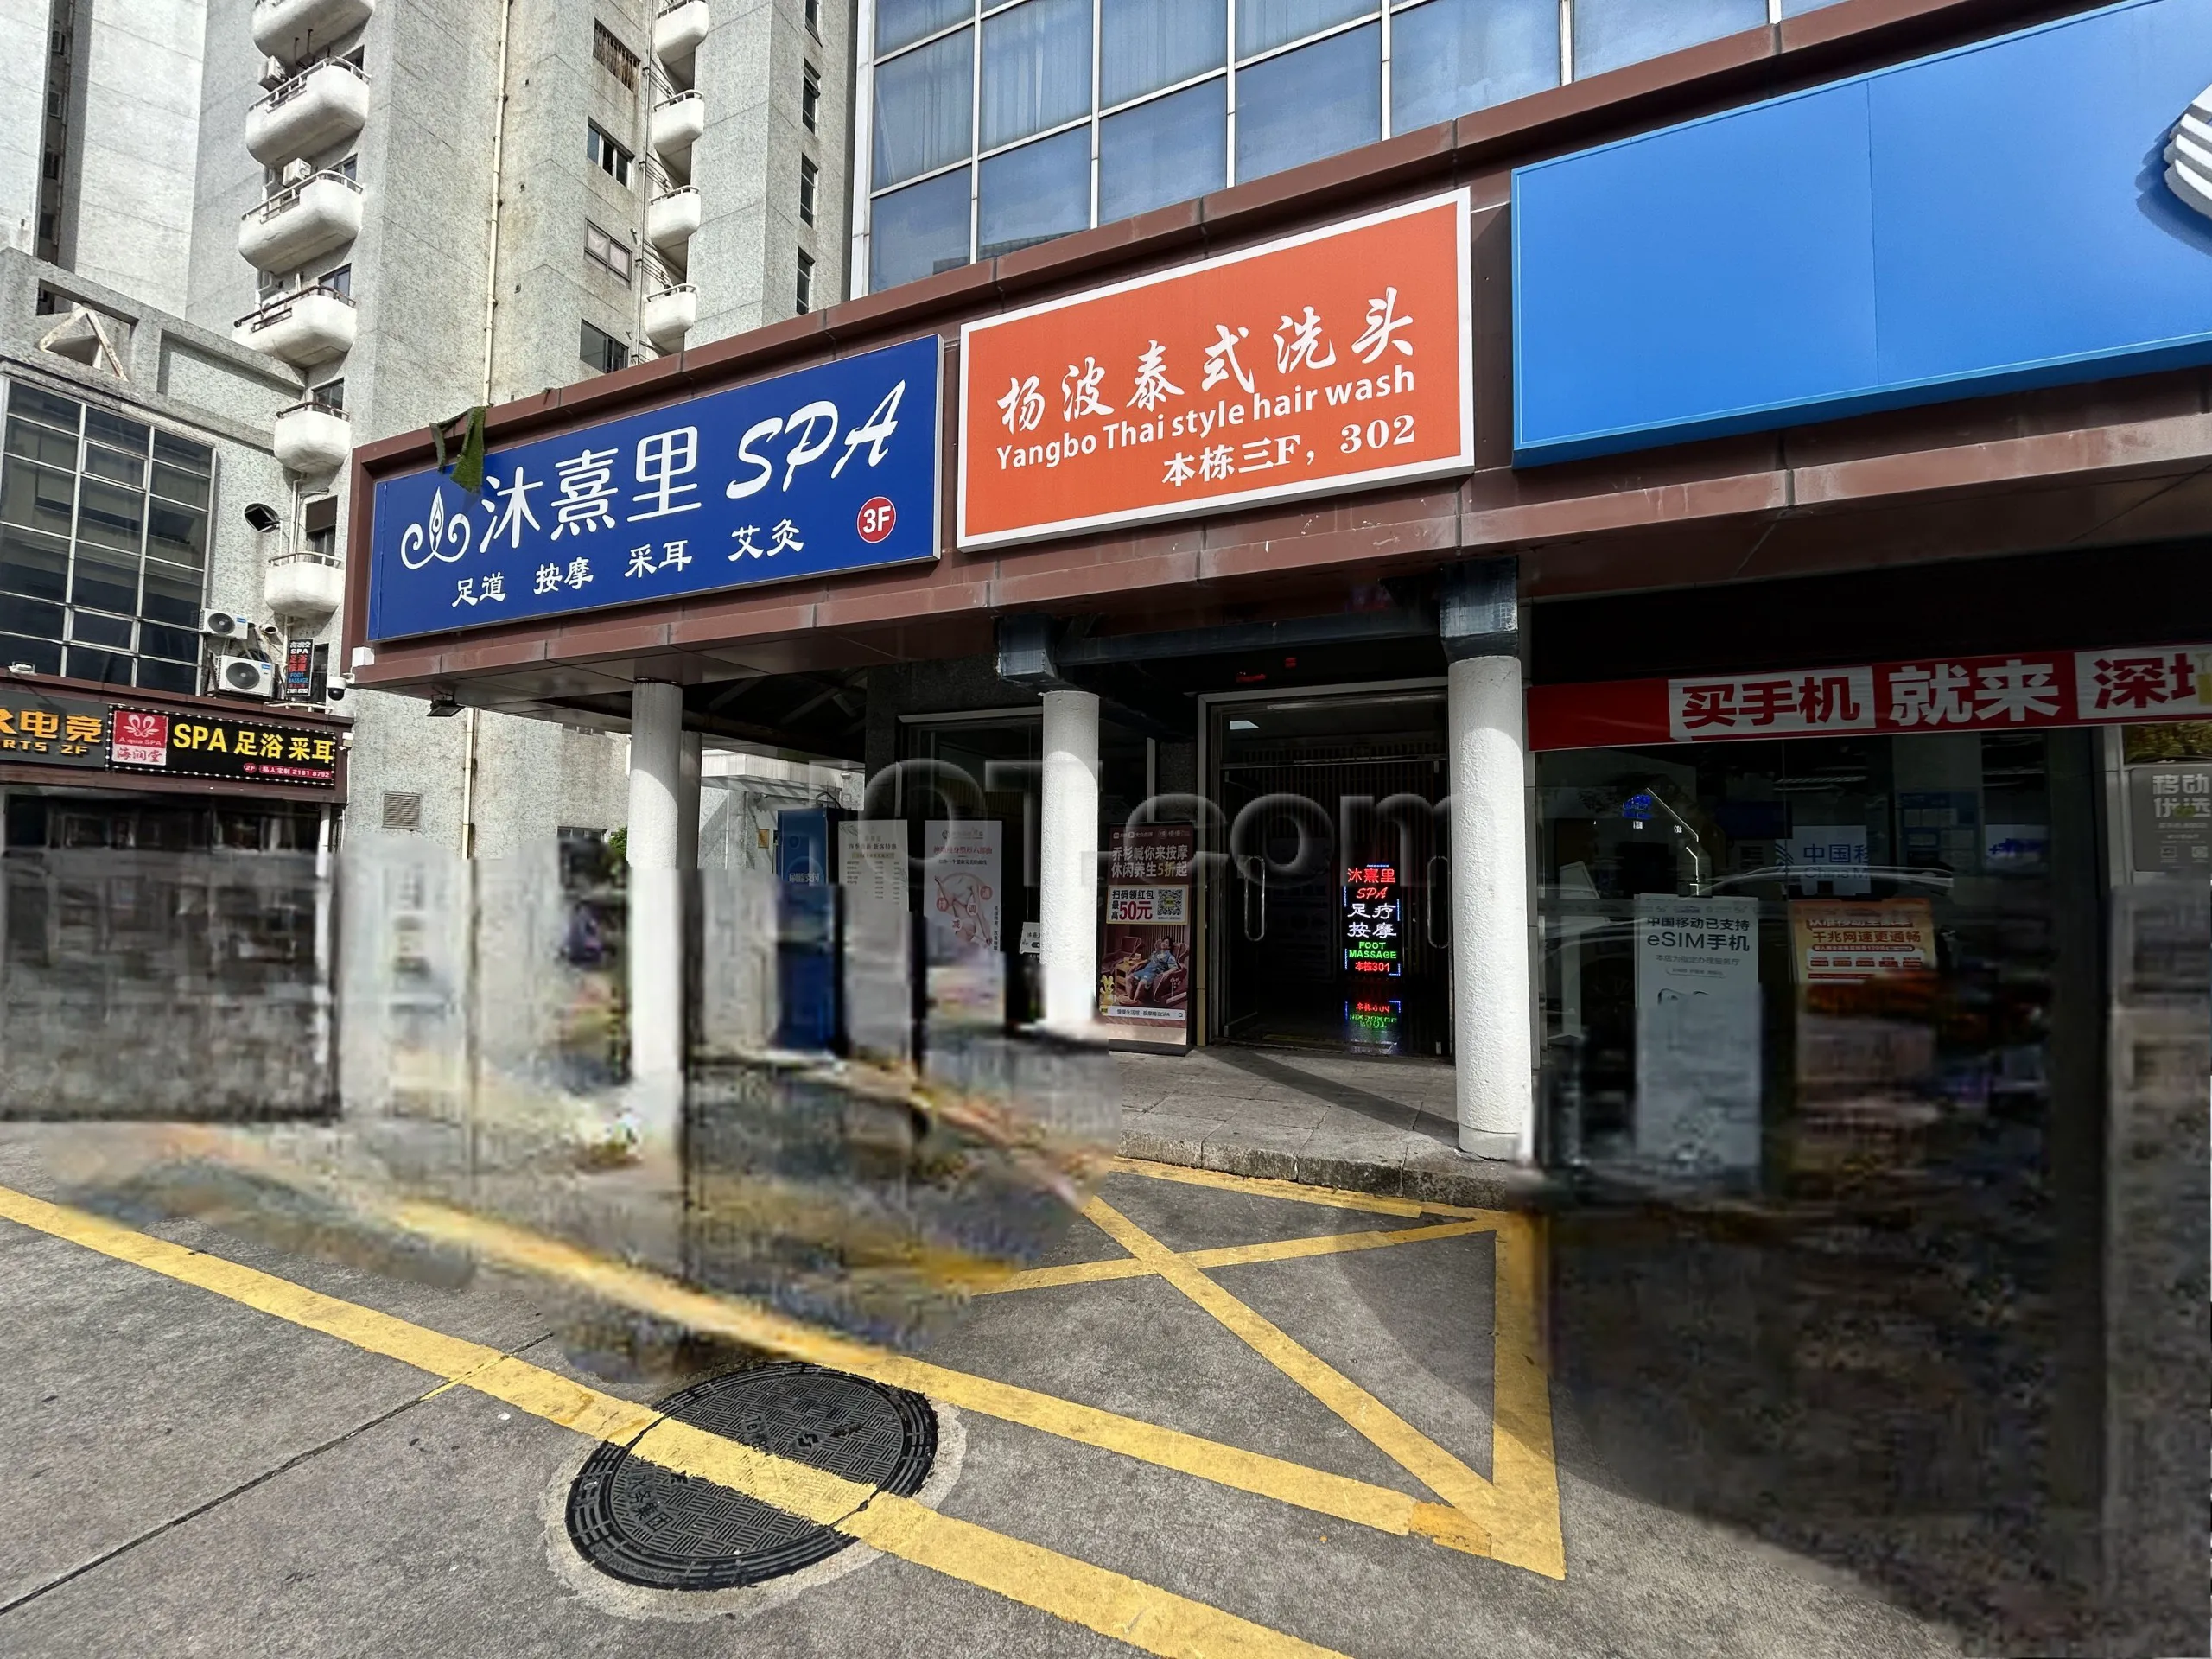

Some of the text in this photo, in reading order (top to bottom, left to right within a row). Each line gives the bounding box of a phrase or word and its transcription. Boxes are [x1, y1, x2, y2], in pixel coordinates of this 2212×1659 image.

[996, 286, 1414, 435] 杨波泰式洗头
[996, 365, 1415, 471] Yangbo Thai style hair wash
[479, 379, 906, 553] 沐熹里 SPA
[862, 504, 891, 534] 3F
[452, 518, 804, 608] 足道 按摩 采耳 艾灸
[1681, 677, 1861, 729] 买手机
[1888, 658, 2062, 726] 就来
[173, 723, 227, 753] SPA
[234, 730, 334, 764] 足浴 采耳
[60, 744, 88, 754] 2F
[2152, 773, 2210, 795] 移动
[1112, 844, 1188, 861] 乔杉喊你来按摩
[1111, 861, 1188, 878] 休闲养生5折起
[1112, 890, 1154, 899] 扫码领红包
[1356, 887, 1389, 899] SPA
[1119, 901, 1154, 921] 50元
[1347, 903, 1396, 919] 足疗
[1347, 922, 1397, 938] 按摩
[1647, 917, 1750, 931] 中国移动已支持
[1358, 941, 1387, 950] FOOT
[1647, 931, 1750, 952] eSIM手机
[1812, 931, 1921, 943] 千兆网速更通畅
[1349, 950, 1397, 959] MASSAGE
